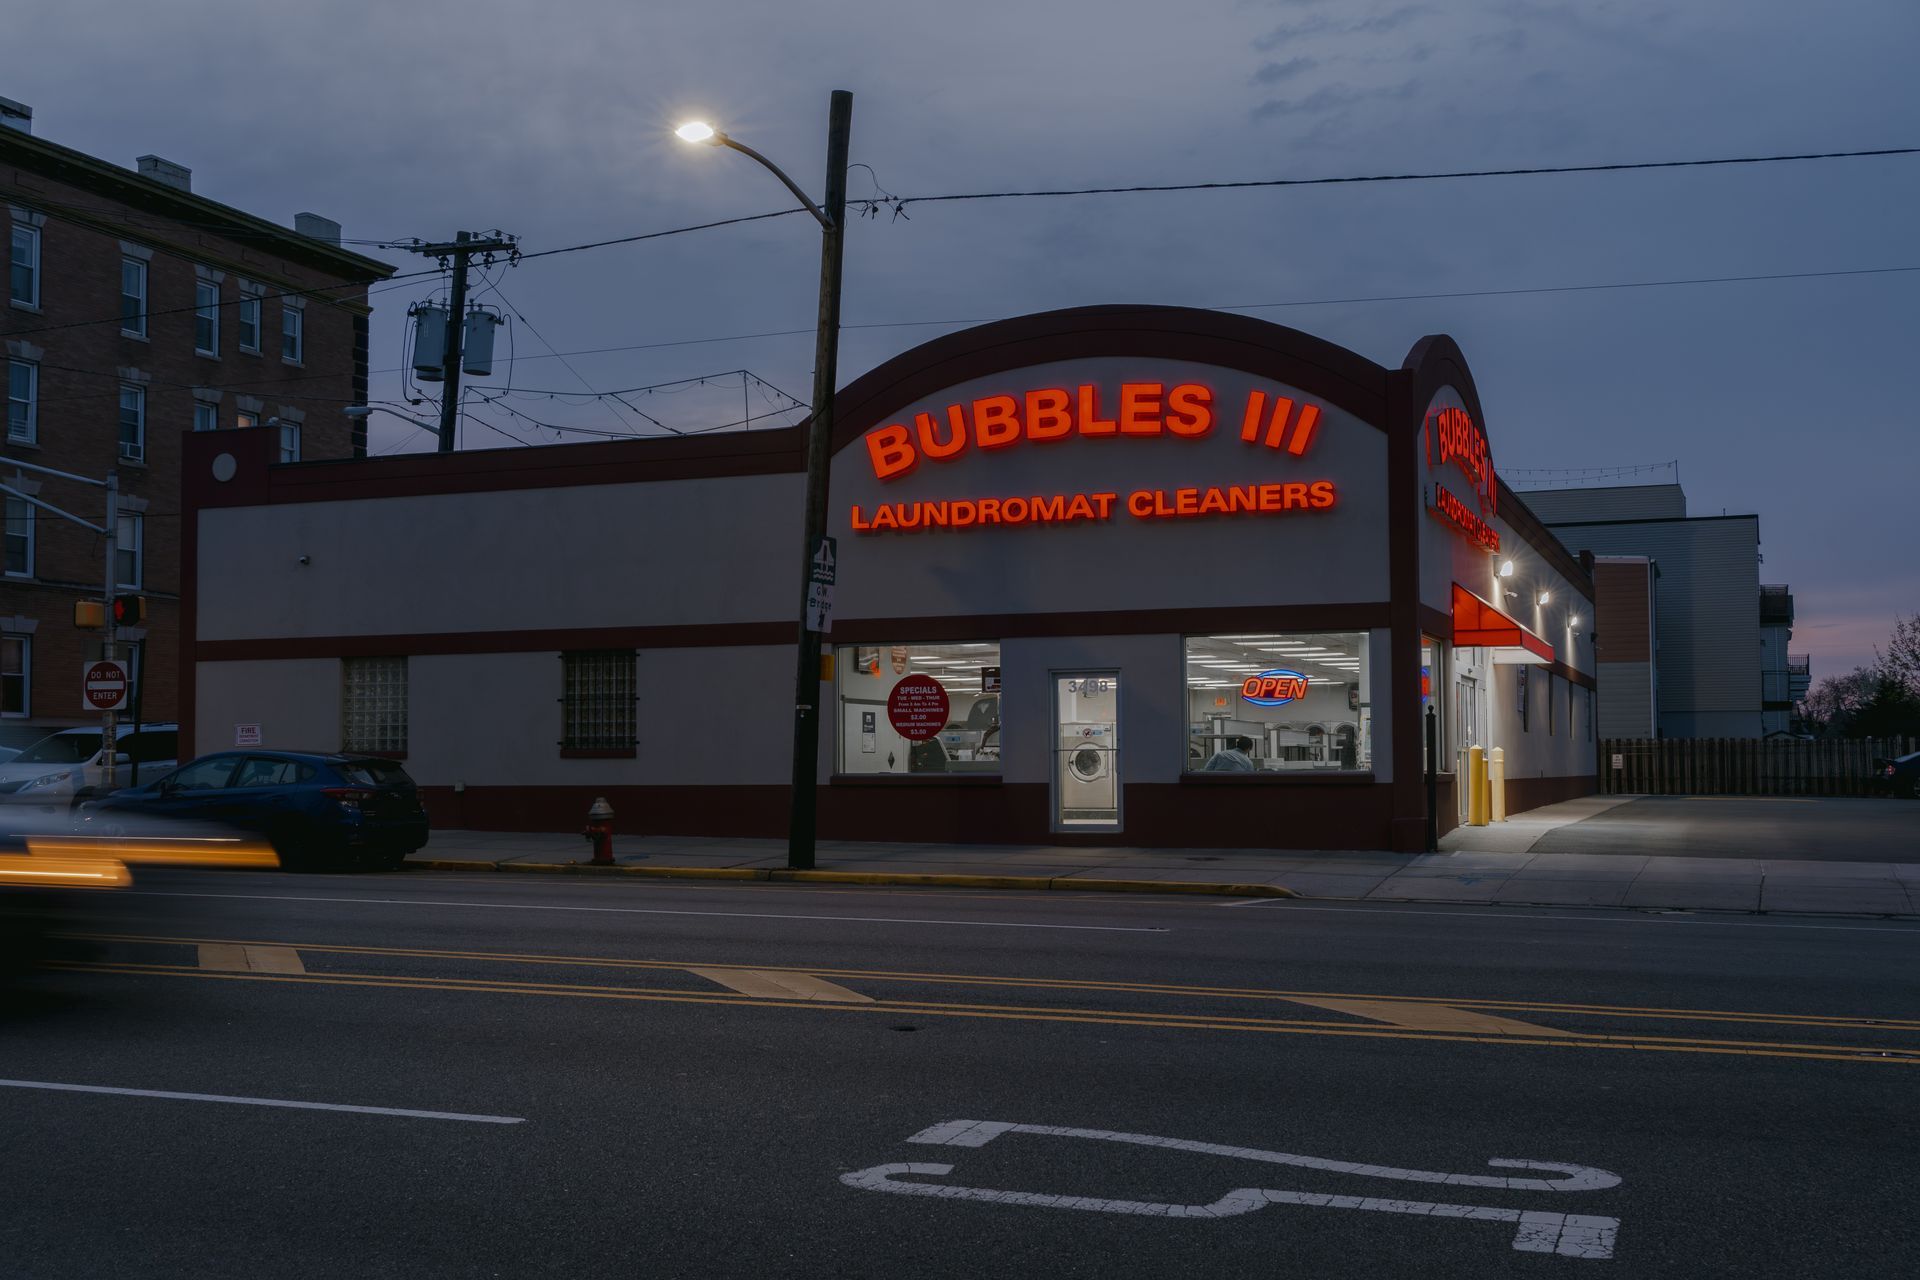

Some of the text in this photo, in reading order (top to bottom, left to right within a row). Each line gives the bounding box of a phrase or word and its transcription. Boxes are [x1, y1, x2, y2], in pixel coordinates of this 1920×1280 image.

[864, 383, 1213, 481] BUBBLES
[1437, 407, 1486, 482] BUBBLES
[851, 480, 1335, 530] LAUNDROMAT CLEANERS
[91, 671, 120, 679] DO NOT
[93, 691, 117, 700] ENTER
[899, 686, 937, 694] SPECIALS
[1068, 680, 1108, 693] 3498
[1242, 676, 1309, 700] OPEN
